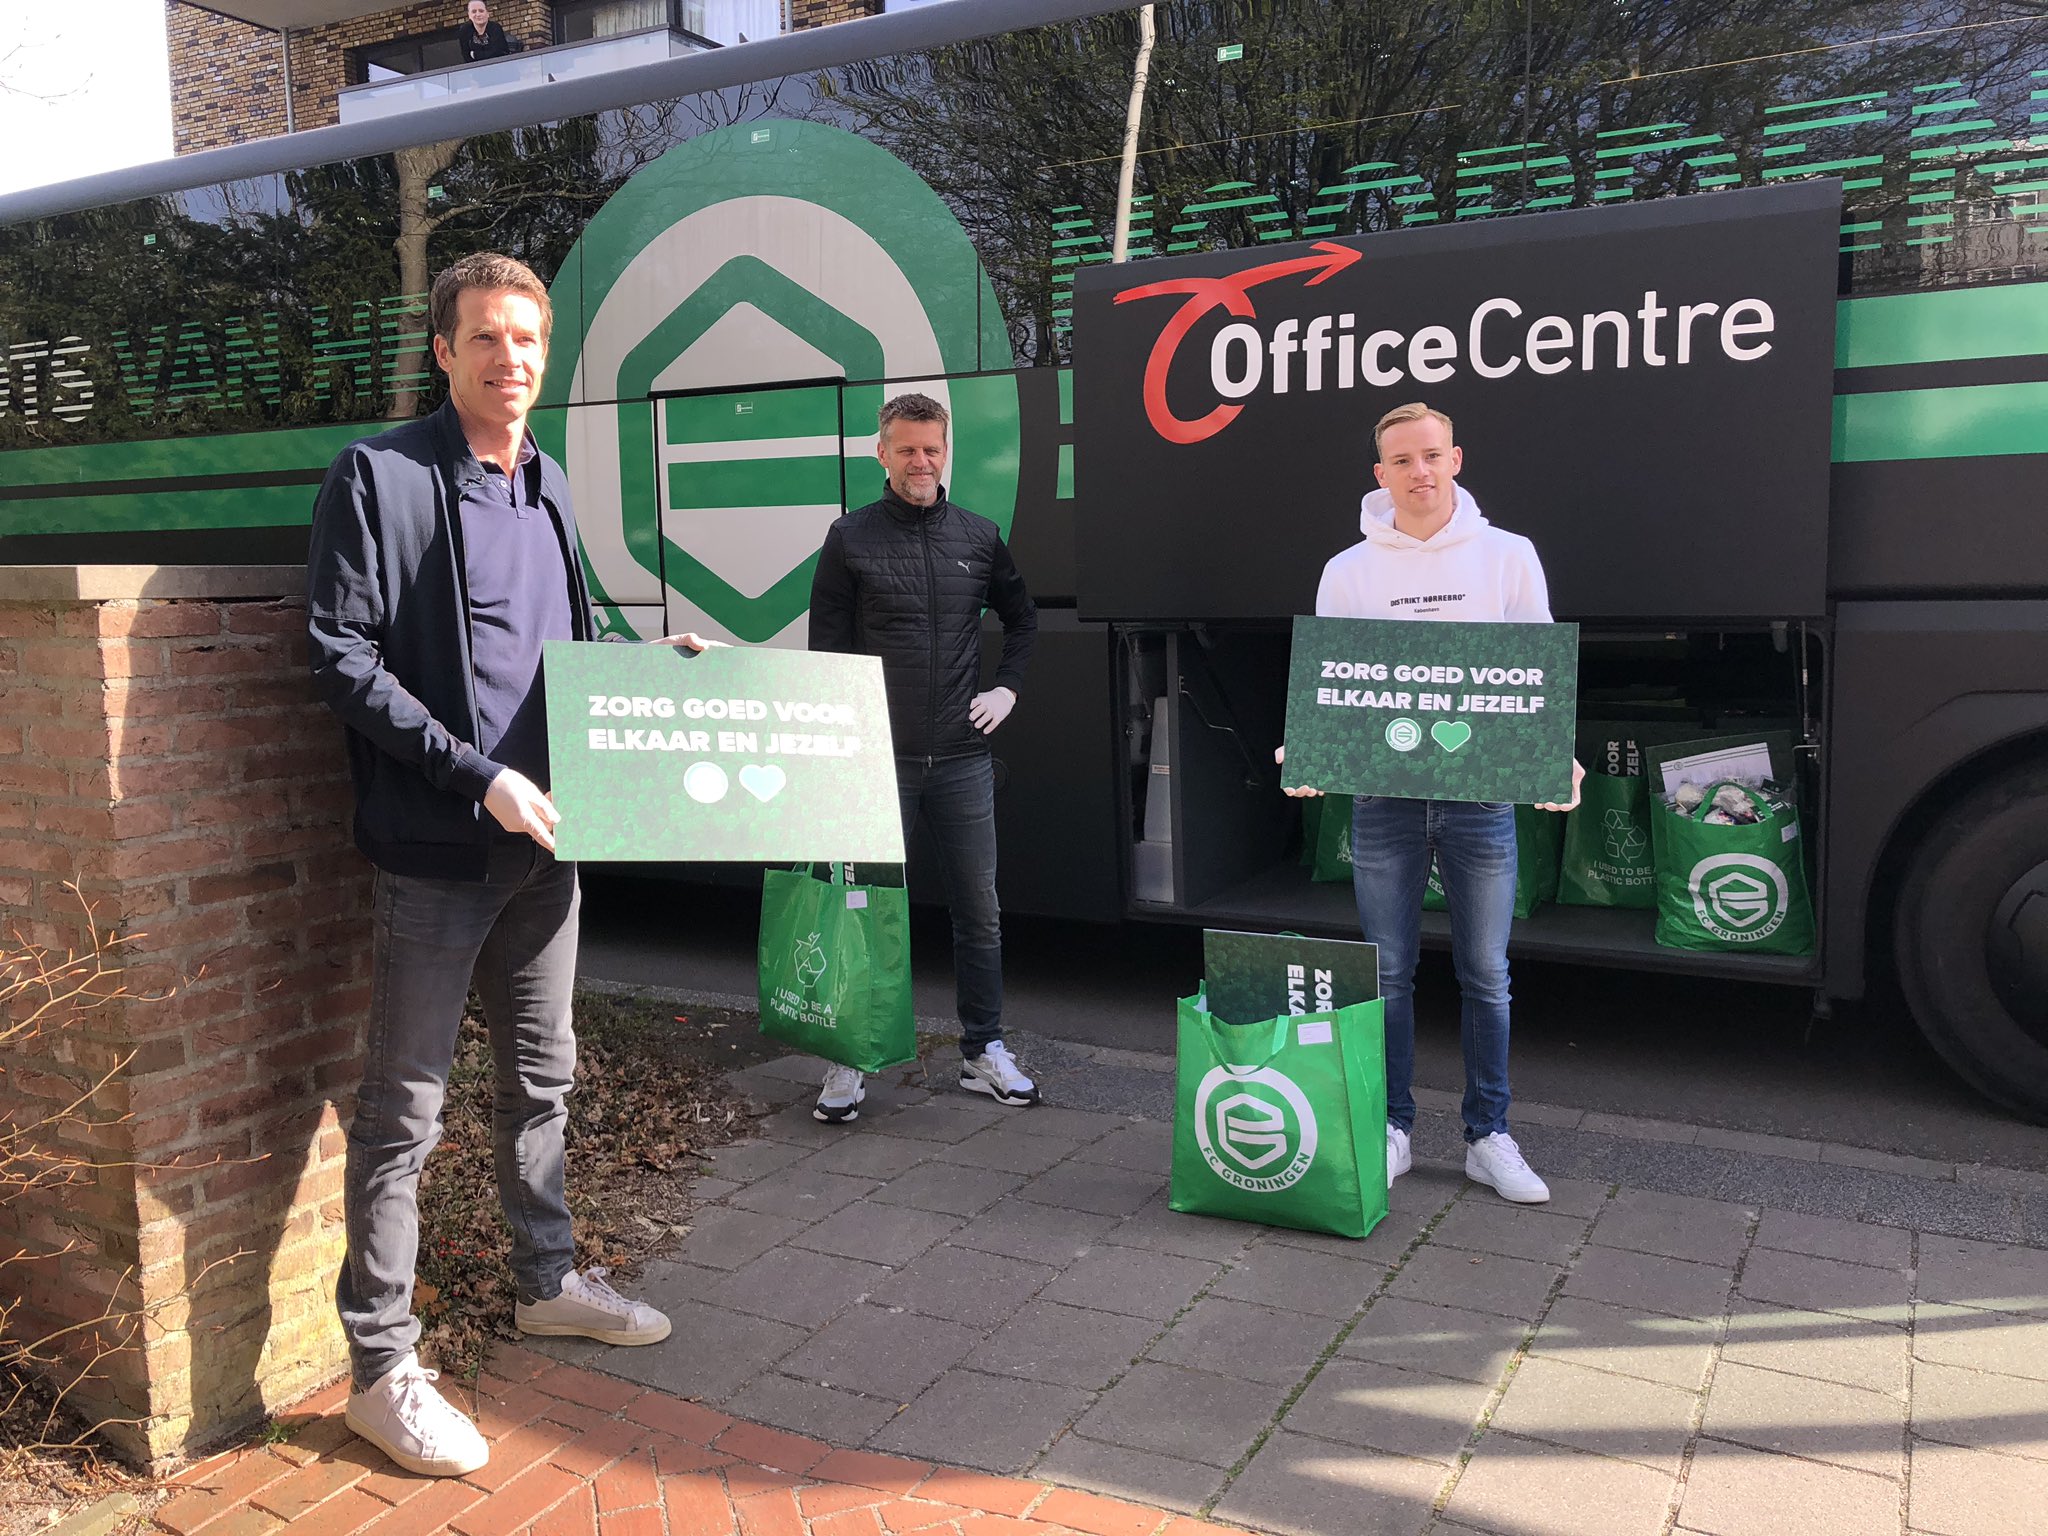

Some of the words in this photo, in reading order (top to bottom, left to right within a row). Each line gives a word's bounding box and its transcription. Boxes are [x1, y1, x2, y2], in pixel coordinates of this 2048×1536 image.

[111, 311, 281, 415] VAN
[1390, 596, 1420, 607] DISTRIKT
[1320, 661, 1388, 681] ZORG
[1393, 664, 1464, 684] GOED
[1469, 667, 1544, 686] VOOR
[588, 695, 676, 719] ZORG
[682, 698, 768, 721] GOED
[1316, 687, 1412, 710] ELKAAR
[1418, 693, 1451, 711] EN
[1456, 694, 1545, 714] JEZELF
[588, 728, 711, 752] ELKAAR
[717, 731, 758, 753] EN
[1607, 741, 1620, 776] OOR
[1587, 869, 1623, 885] PLASTIC
[1626, 876, 1657, 886] BOTT
[1599, 861, 1618, 874] USED
[1620, 867, 1634, 876] TO
[1636, 866, 1651, 876] BE
[1697, 909, 1709, 924] FC
[1711, 911, 1785, 941] GRONINGEN
[770, 997, 798, 1020] PLASTIC
[800, 1013, 837, 1028] BOTTLE
[775, 986, 779, 996] I
[780, 988, 800, 1006] USED
[811, 1000, 822, 1013] BE
[823, 1004, 832, 1014] A
[1203, 1146, 1219, 1166] FC
[1222, 1153, 1310, 1190] GRONINGEN
